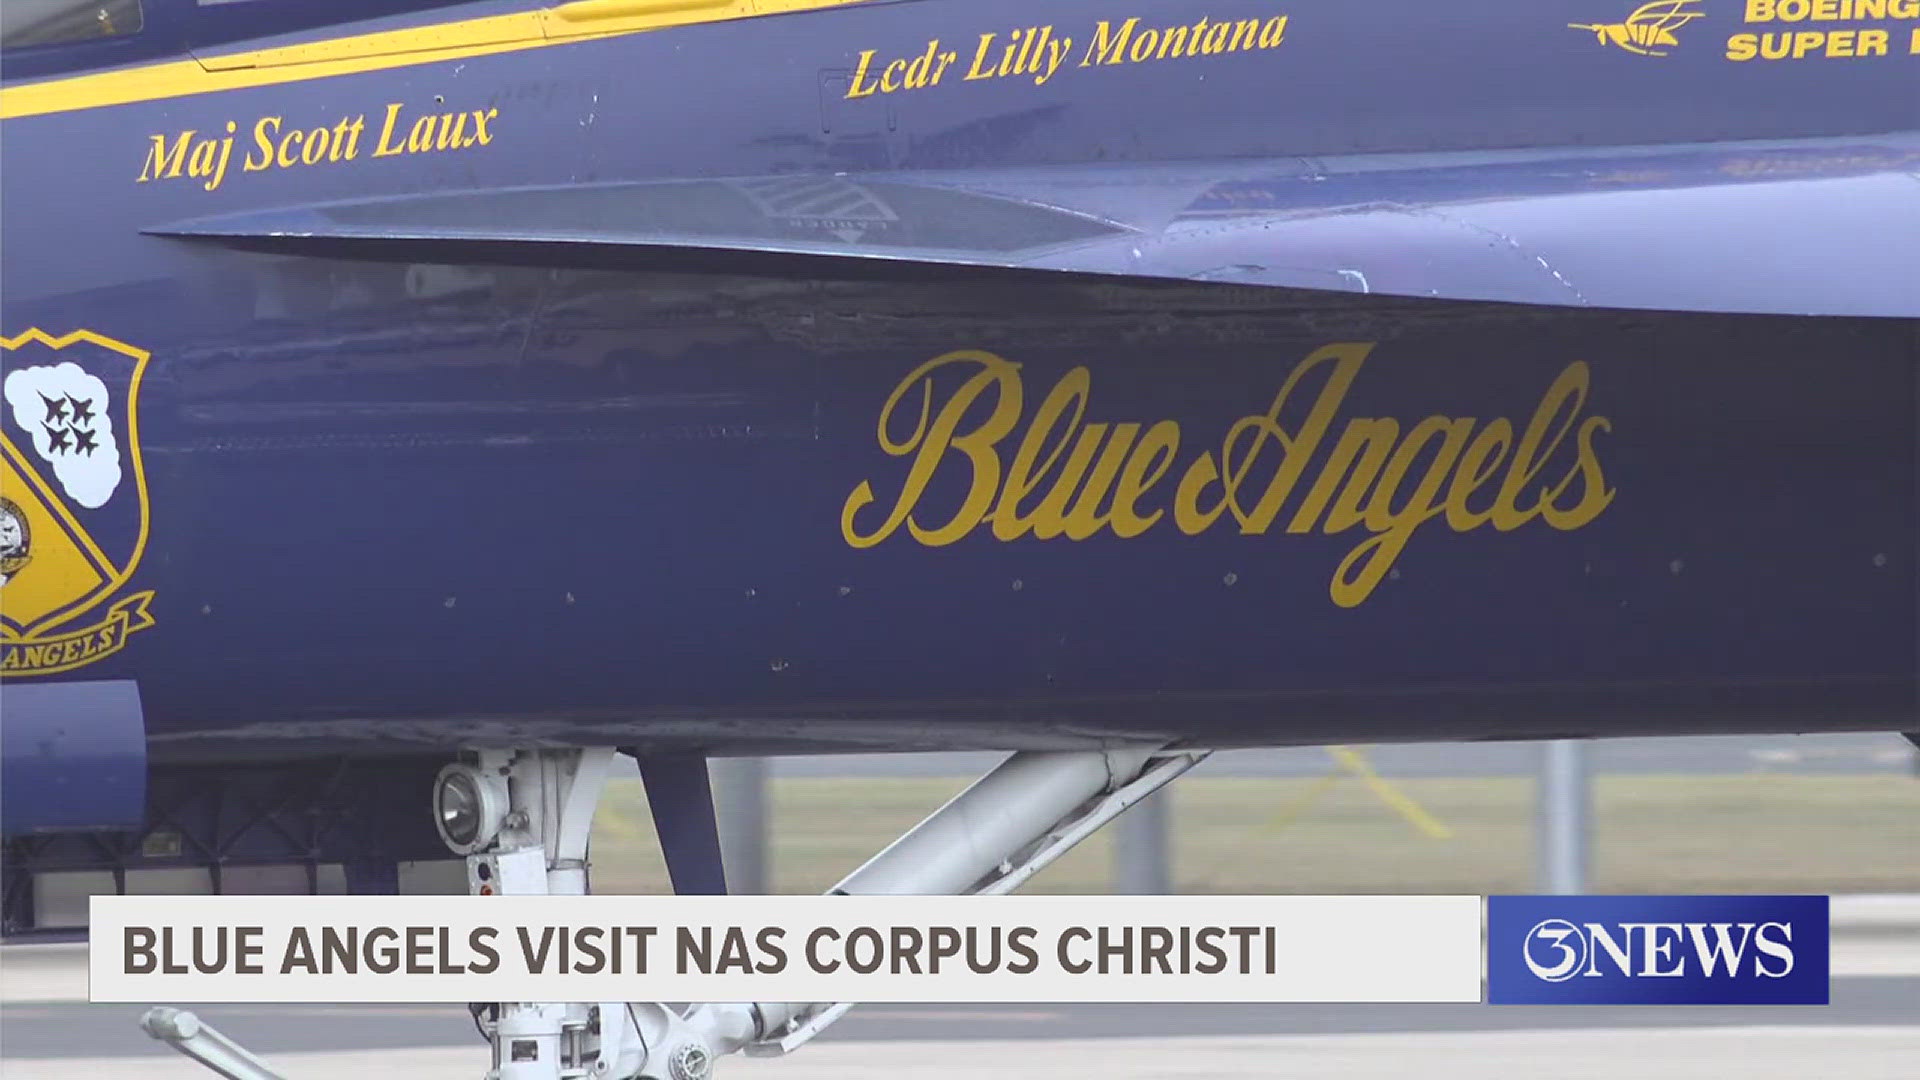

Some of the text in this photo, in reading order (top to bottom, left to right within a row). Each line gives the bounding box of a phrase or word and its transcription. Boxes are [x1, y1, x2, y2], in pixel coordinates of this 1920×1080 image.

[1745, 0, 1920, 23] BOEING
[848, 15, 1288, 99] Lcdr Lilly Montana
[1725, 29, 1889, 61] SUPER
[138, 102, 500, 191] Maj Scott Laux
[841, 343, 1616, 608] Blue Angels
[2, 624, 116, 669] ANGELS
